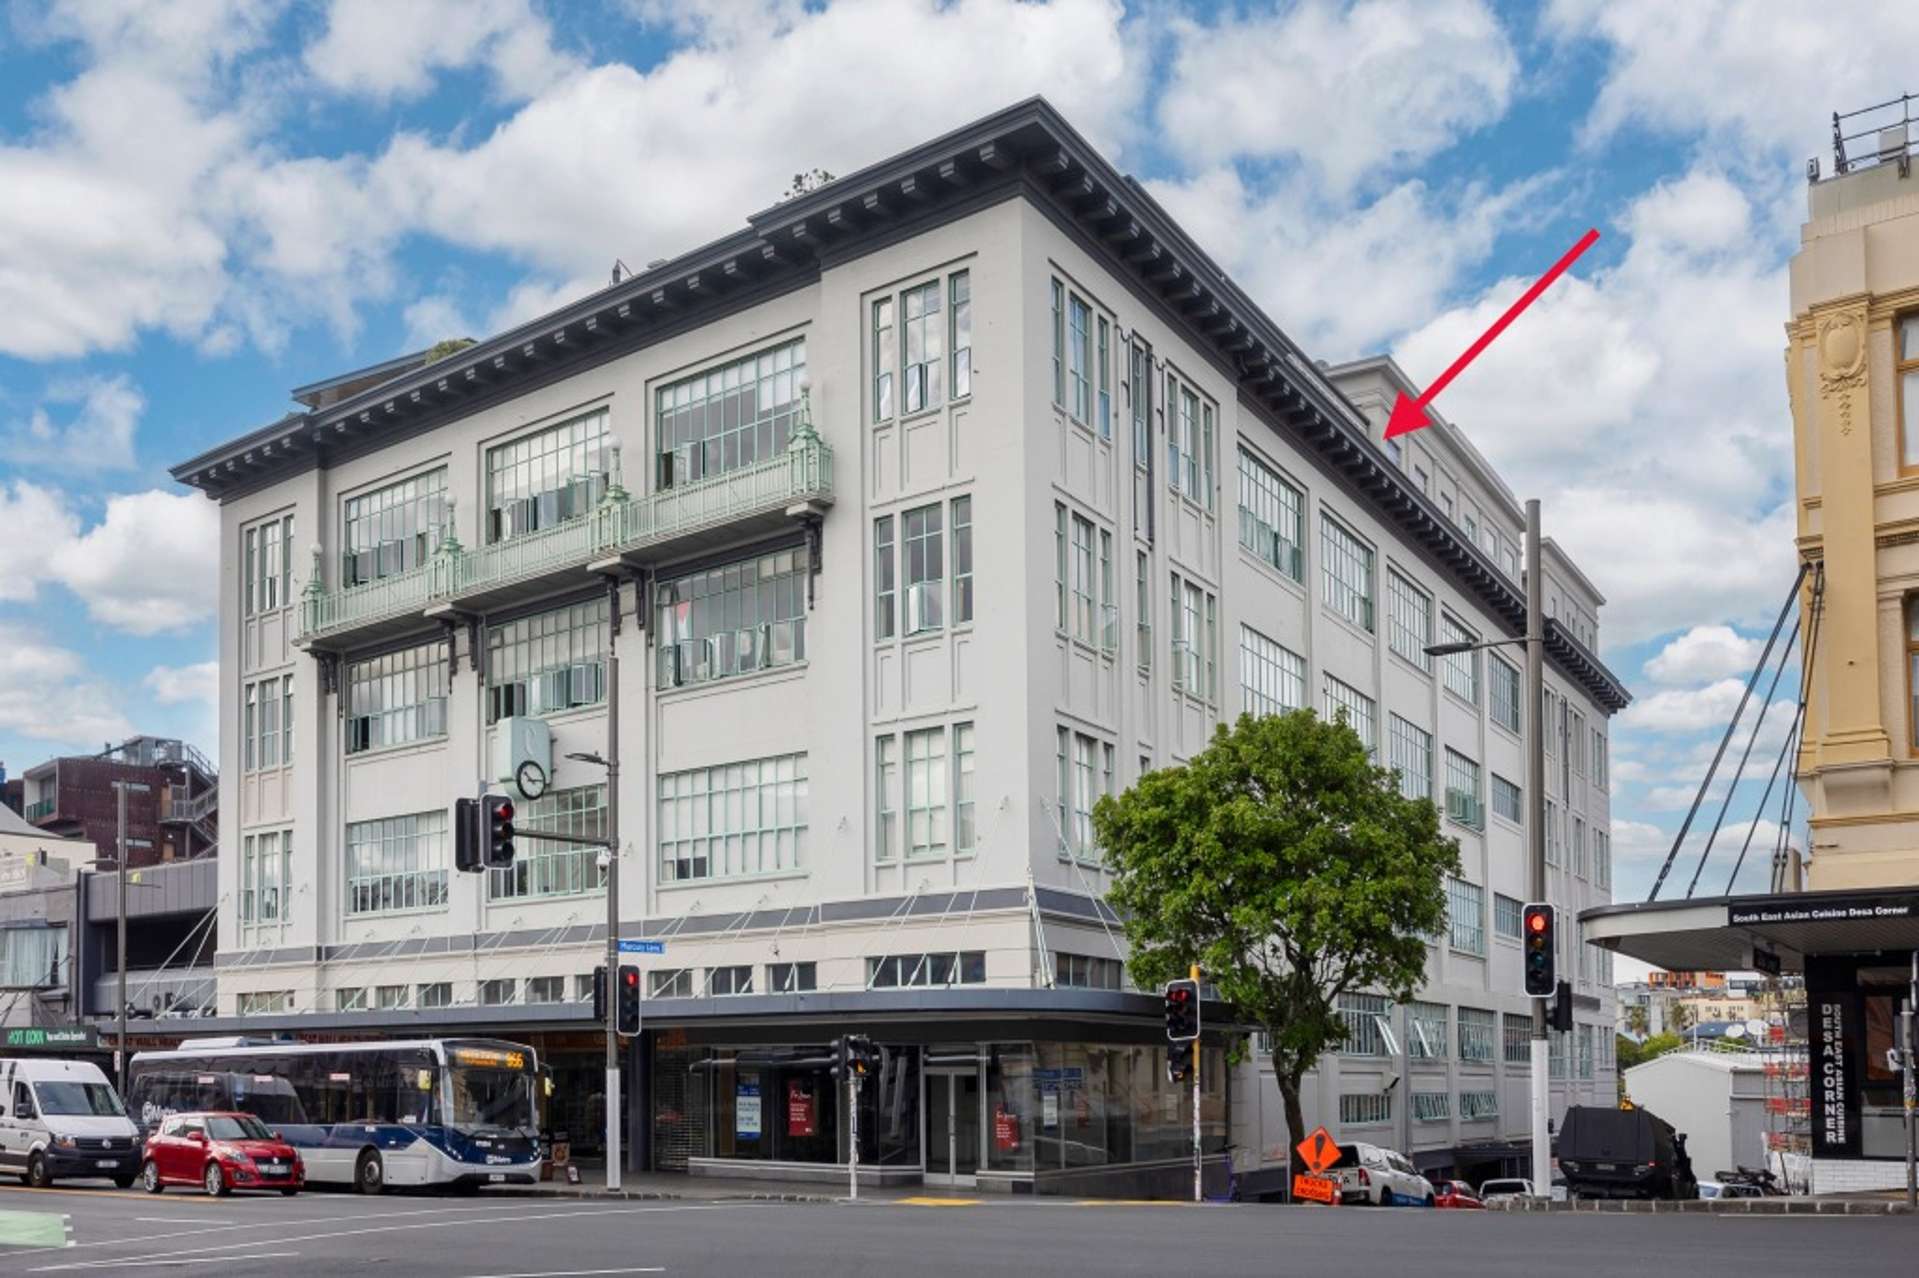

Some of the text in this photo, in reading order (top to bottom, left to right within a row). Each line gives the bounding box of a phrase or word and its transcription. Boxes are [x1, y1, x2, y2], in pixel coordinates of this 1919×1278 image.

[1733, 906, 1909, 923] South East Asian Cuisine Desa Corner
[1821, 1003, 1837, 1144] DESA CORNER
[1833, 1004, 1847, 1144] SOUTH EAST ASIAN CUISINE
